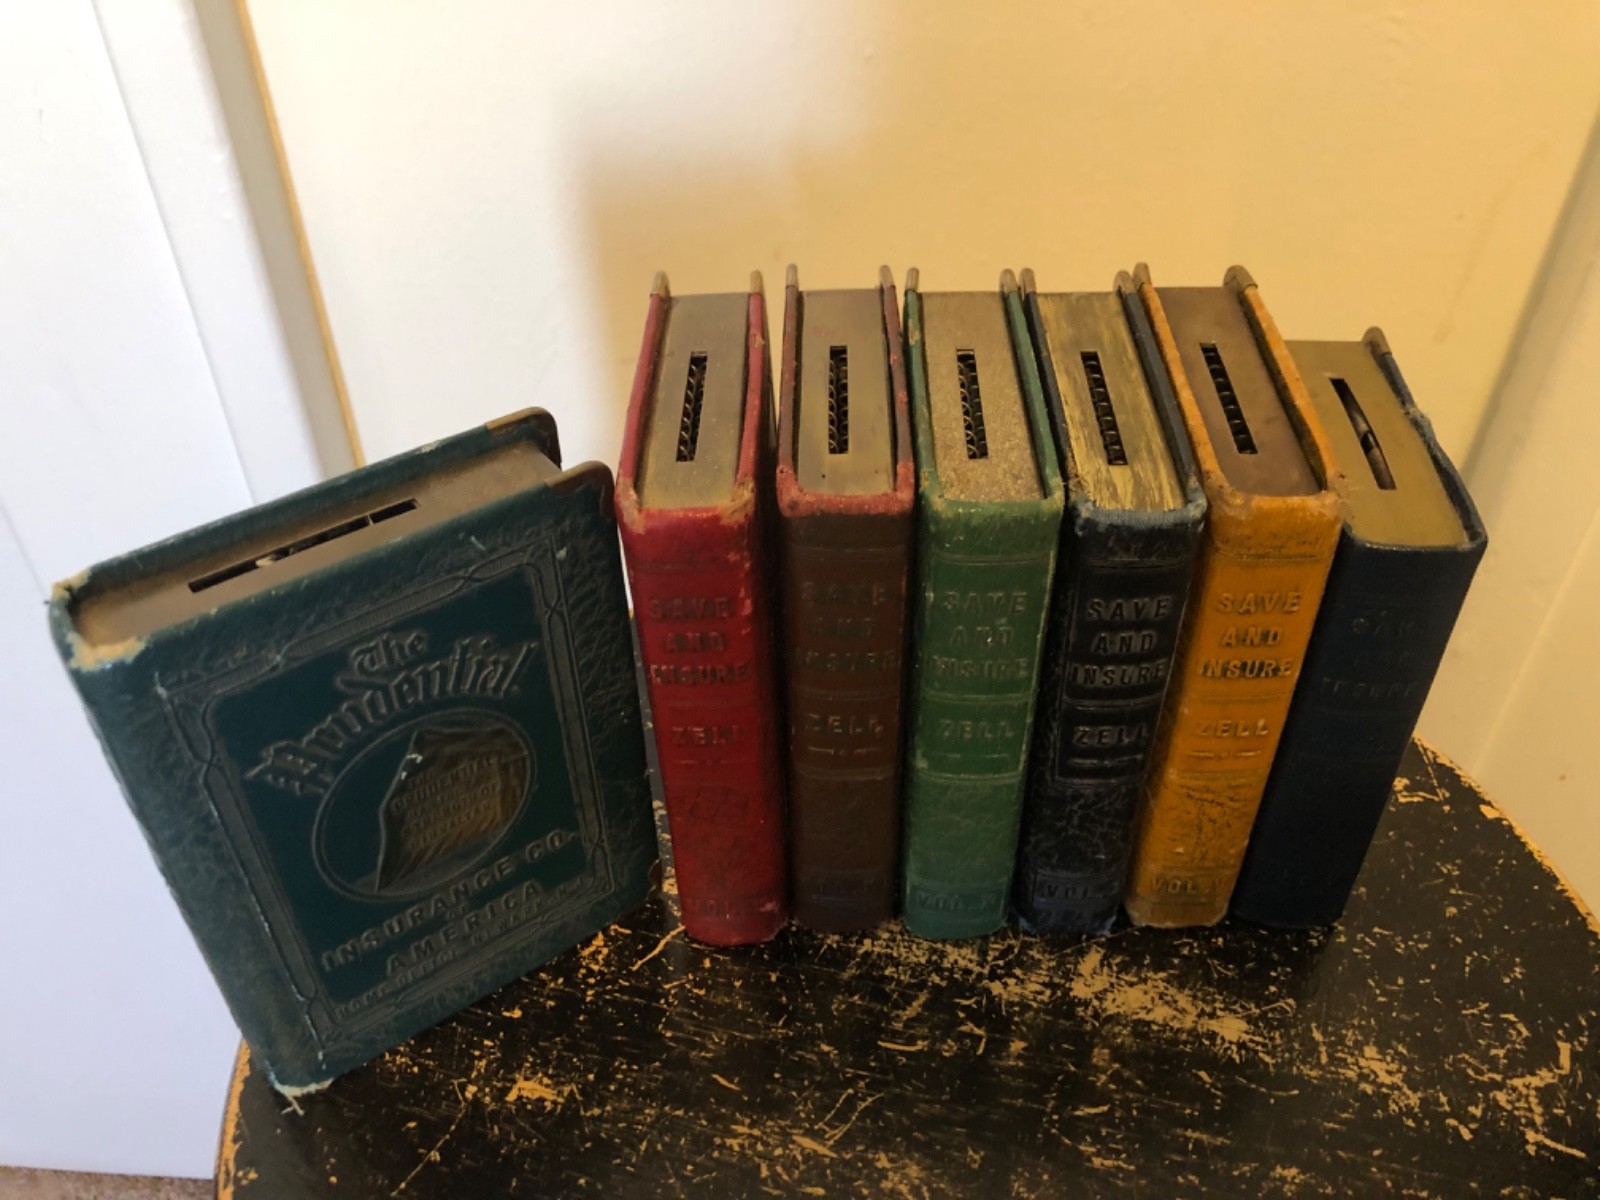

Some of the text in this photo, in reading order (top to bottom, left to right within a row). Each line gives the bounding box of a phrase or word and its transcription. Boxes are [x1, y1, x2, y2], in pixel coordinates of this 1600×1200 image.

[1086, 596, 1173, 620] SAVE
[1216, 591, 1302, 616] SAVE
[1091, 630, 1159, 654] AND
[1219, 625, 1284, 648] AND
[349, 630, 427, 675] The
[1070, 658, 1170, 686] INSURE
[1199, 657, 1296, 680] INSURE
[806, 712, 886, 738] ZELL
[940, 719, 1016, 740] ZELL
[1072, 724, 1149, 747] ZELL
[1197, 717, 1270, 740] ZELL
[321, 855, 516, 973] INSURANCE
[386, 879, 544, 977] AMERICA
